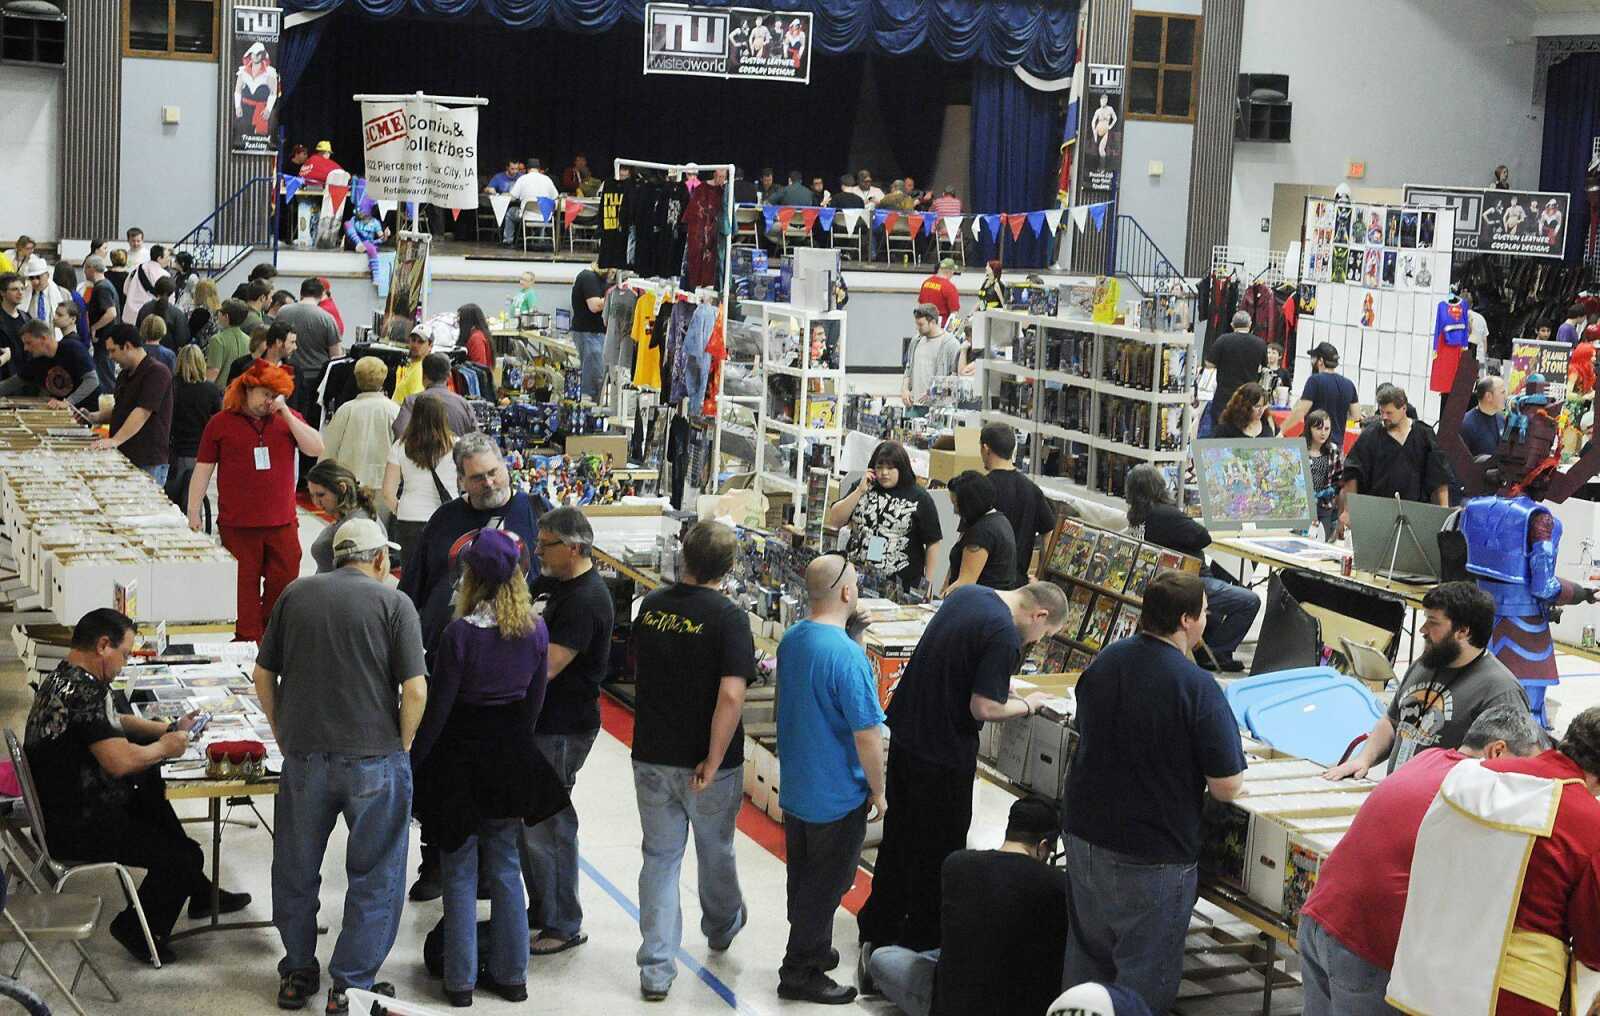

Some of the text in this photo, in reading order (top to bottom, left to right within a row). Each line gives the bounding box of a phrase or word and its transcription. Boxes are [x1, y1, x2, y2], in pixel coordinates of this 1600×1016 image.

[655, 14, 725, 53] TW
[648, 56, 727, 72] twistedworld
[1540, 360, 1569, 374] STONE
